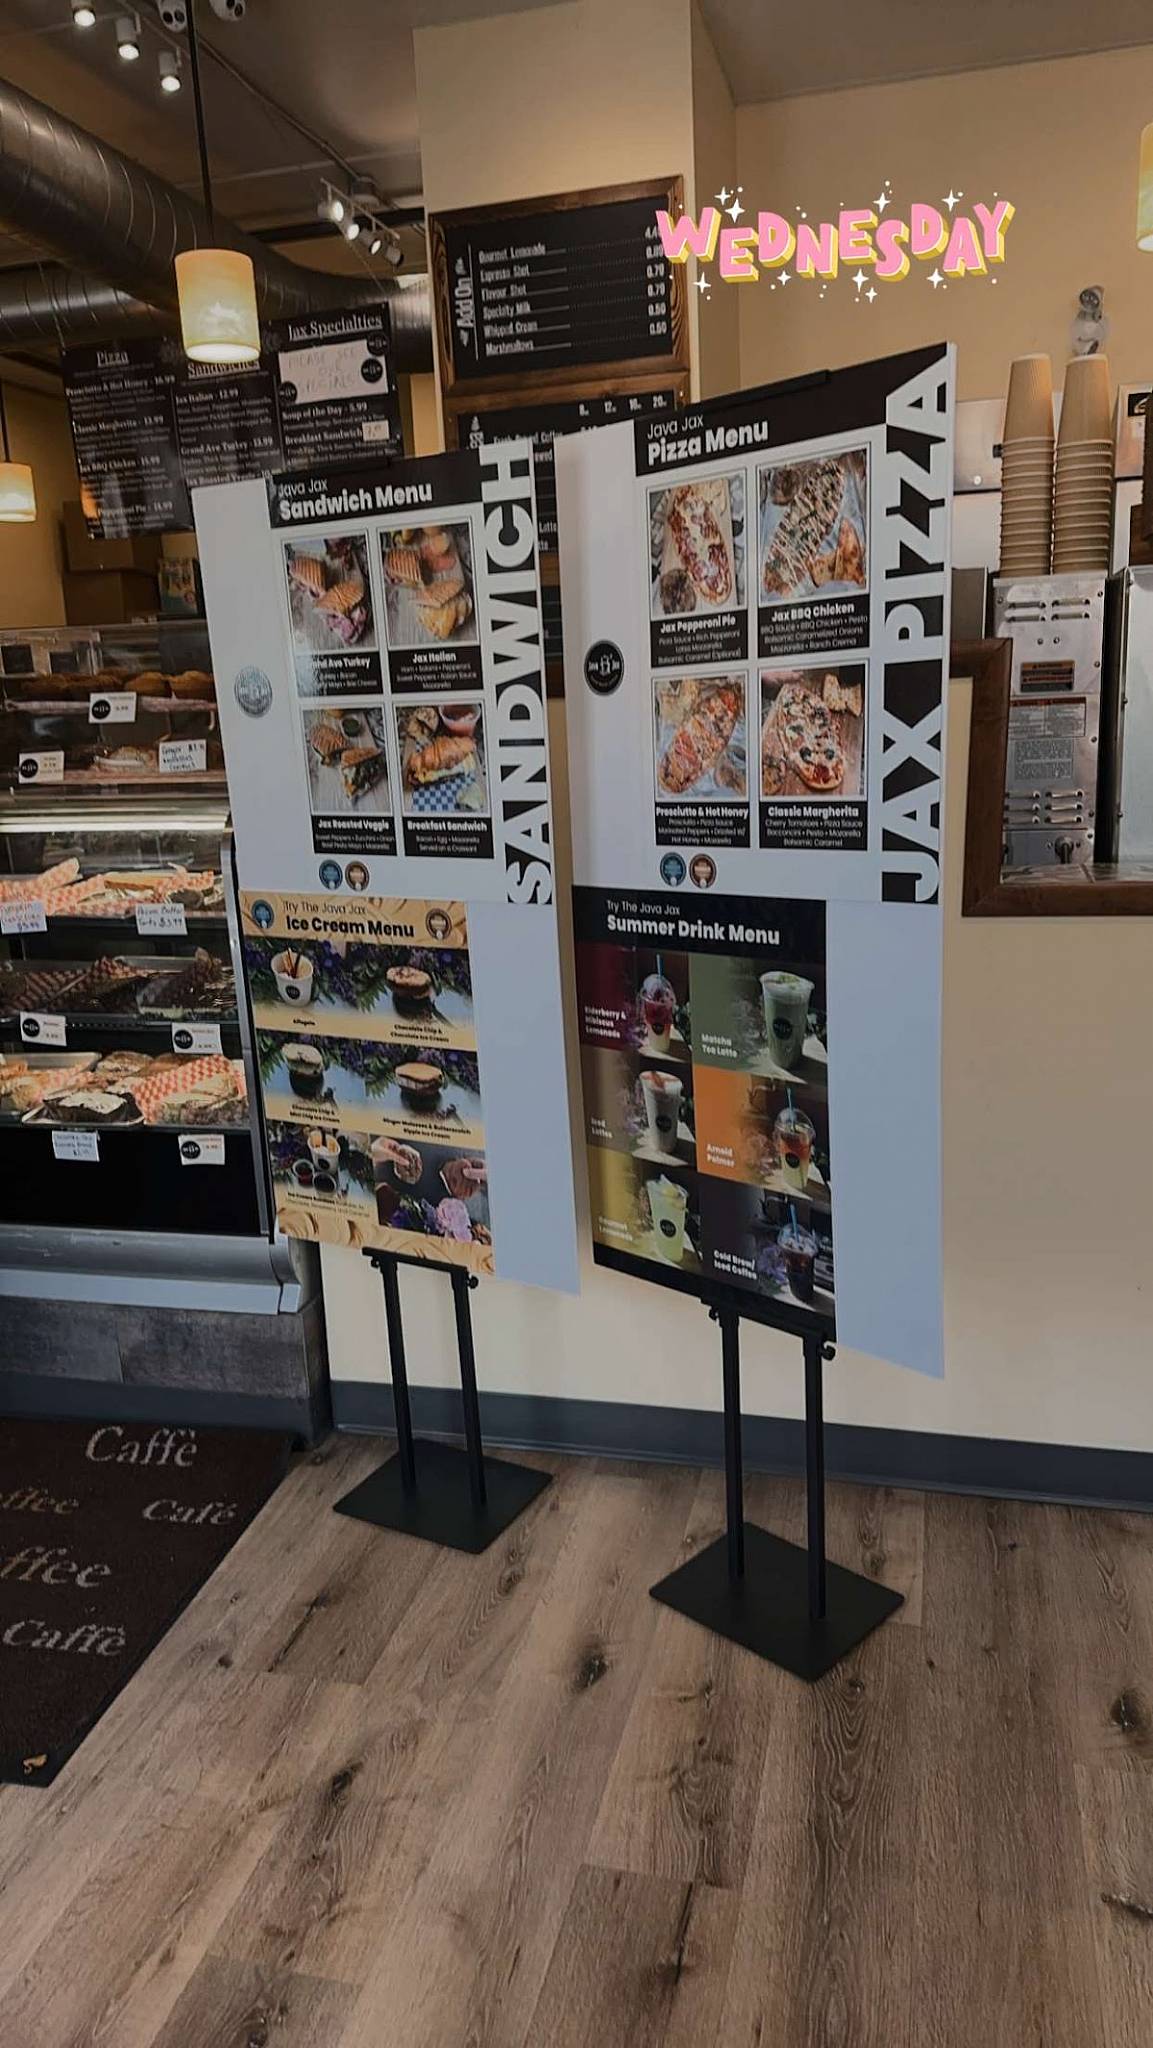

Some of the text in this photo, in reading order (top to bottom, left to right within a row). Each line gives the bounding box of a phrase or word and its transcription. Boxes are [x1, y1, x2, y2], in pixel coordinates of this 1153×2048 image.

[288, 313, 383, 342] Jax Specialties
[95, 351, 129, 367] Pizza
[647, 414, 704, 440] Java Jax
[648, 421, 769, 467] Pizza Menu
[278, 478, 329, 500] Java Jax
[279, 482, 434, 521] Sandwich Menu
[771, 602, 855, 622] Jax BBQ Chicken
[660, 613, 737, 634] Jax Pepperoni Pie
[882, 350, 949, 905] JAX PIZZA
[343, 655, 370, 670] Turkey
[413, 650, 457, 664] Jax Italian
[479, 437, 553, 905] SANDWICH
[656, 805, 749, 820] Prosciutto & Hot Honey
[768, 804, 860, 820] Classic Margherita
[318, 818, 389, 833] Jax Roasted Veggie
[407, 819, 488, 832] Breakfast Sandwich
[283, 900, 368, 915] Try The Java Jax
[606, 899, 681, 916] Try The Java Jax
[287, 915, 415, 937] Ice Cream Menu
[606, 914, 781, 946] Summer Drink Menu
[585, 1024, 621, 1039] Lemonade
[701, 1032, 732, 1046] Matcha
[702, 1044, 738, 1058] Tea Latte
[706, 1143, 733, 1158] Arnold
[706, 1153, 735, 1168] Palmer
[713, 1249, 732, 1262] Cold
[713, 1259, 758, 1280] Iced Coffee
